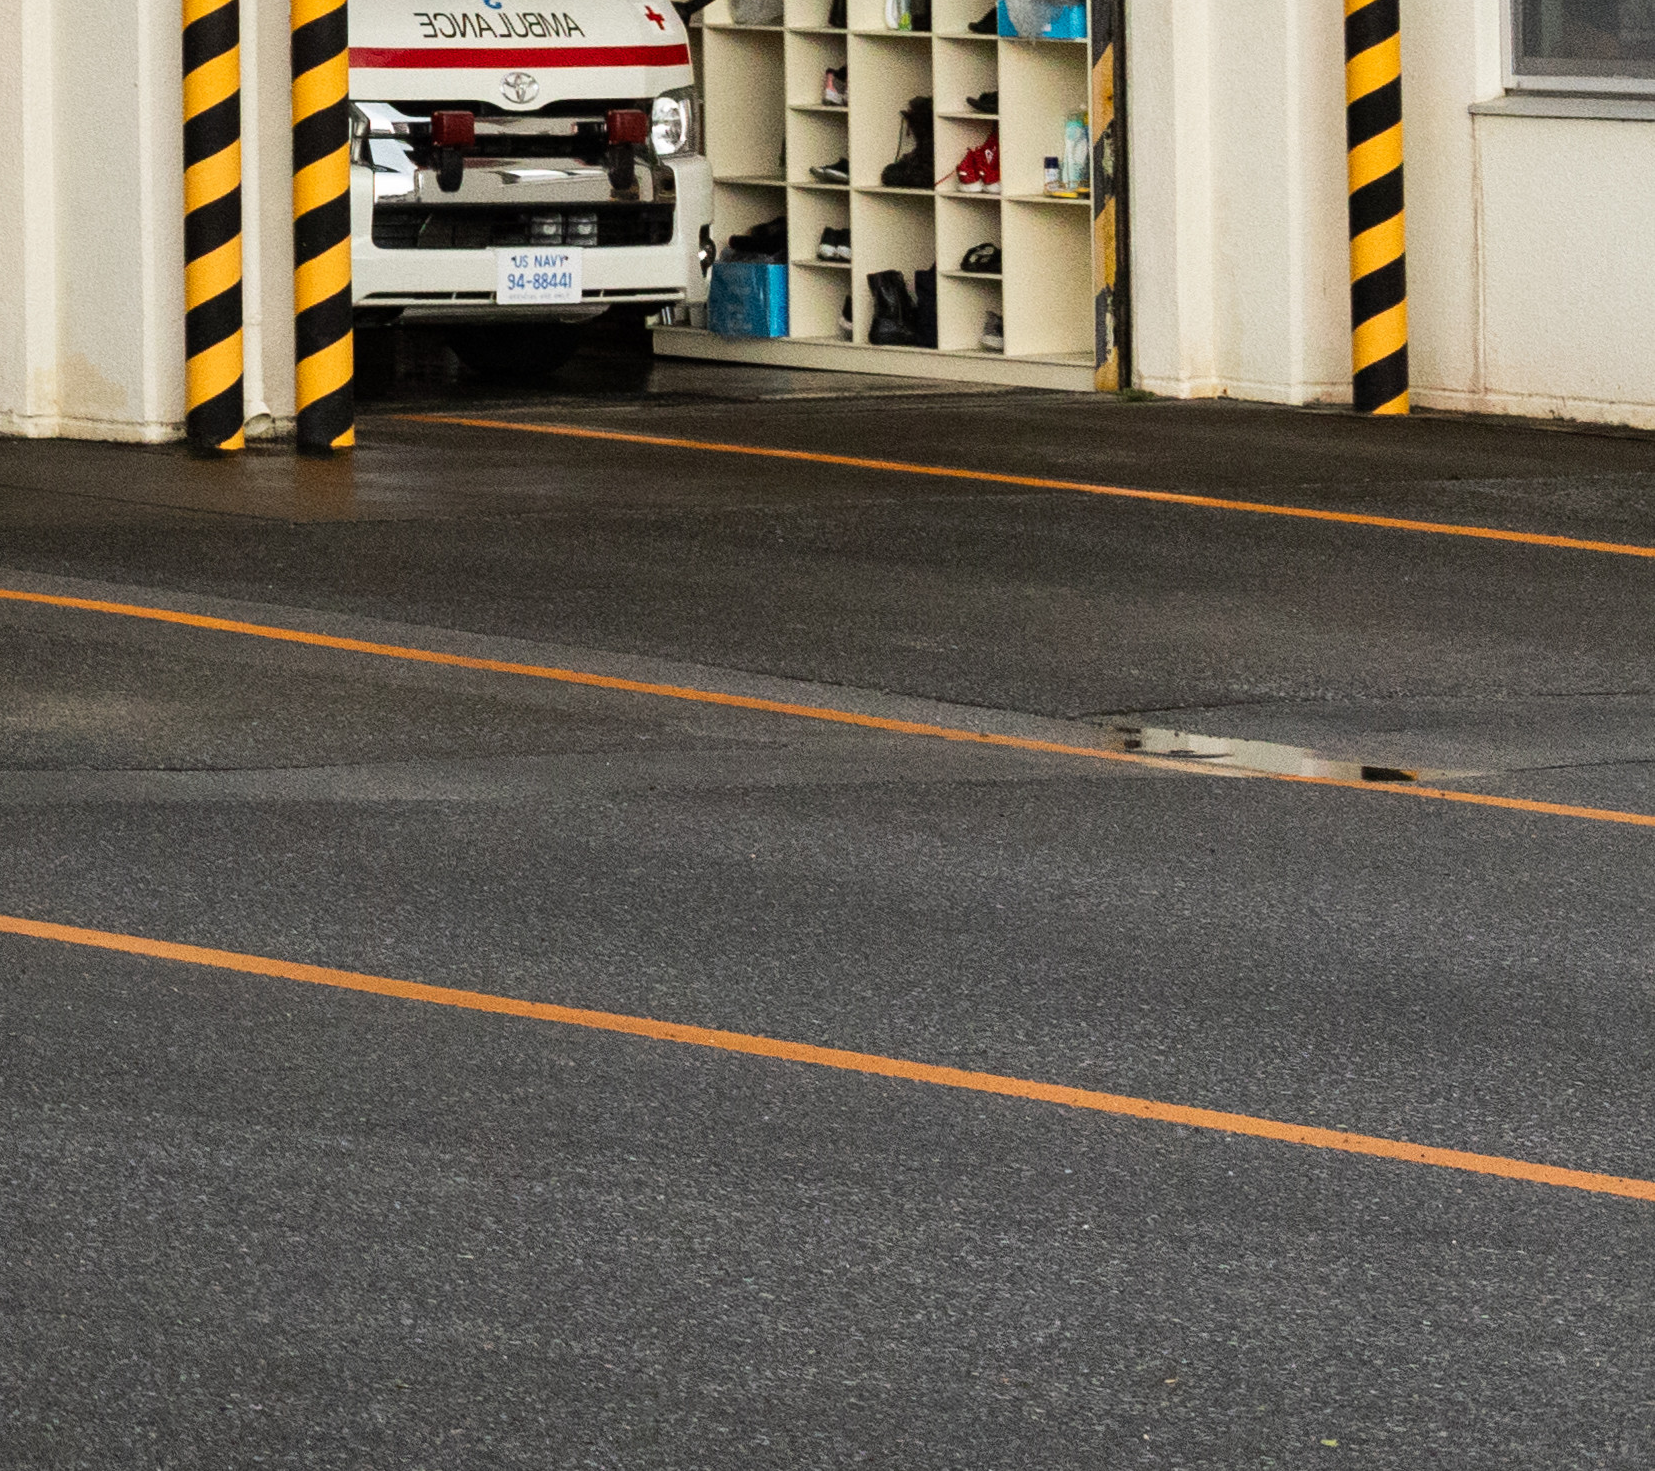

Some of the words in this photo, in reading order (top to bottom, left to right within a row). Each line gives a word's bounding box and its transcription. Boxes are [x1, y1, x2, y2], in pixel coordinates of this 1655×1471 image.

[514, 254, 529, 268] US
[534, 254, 565, 267] NAVY
[507, 272, 572, 290] 94-88441
